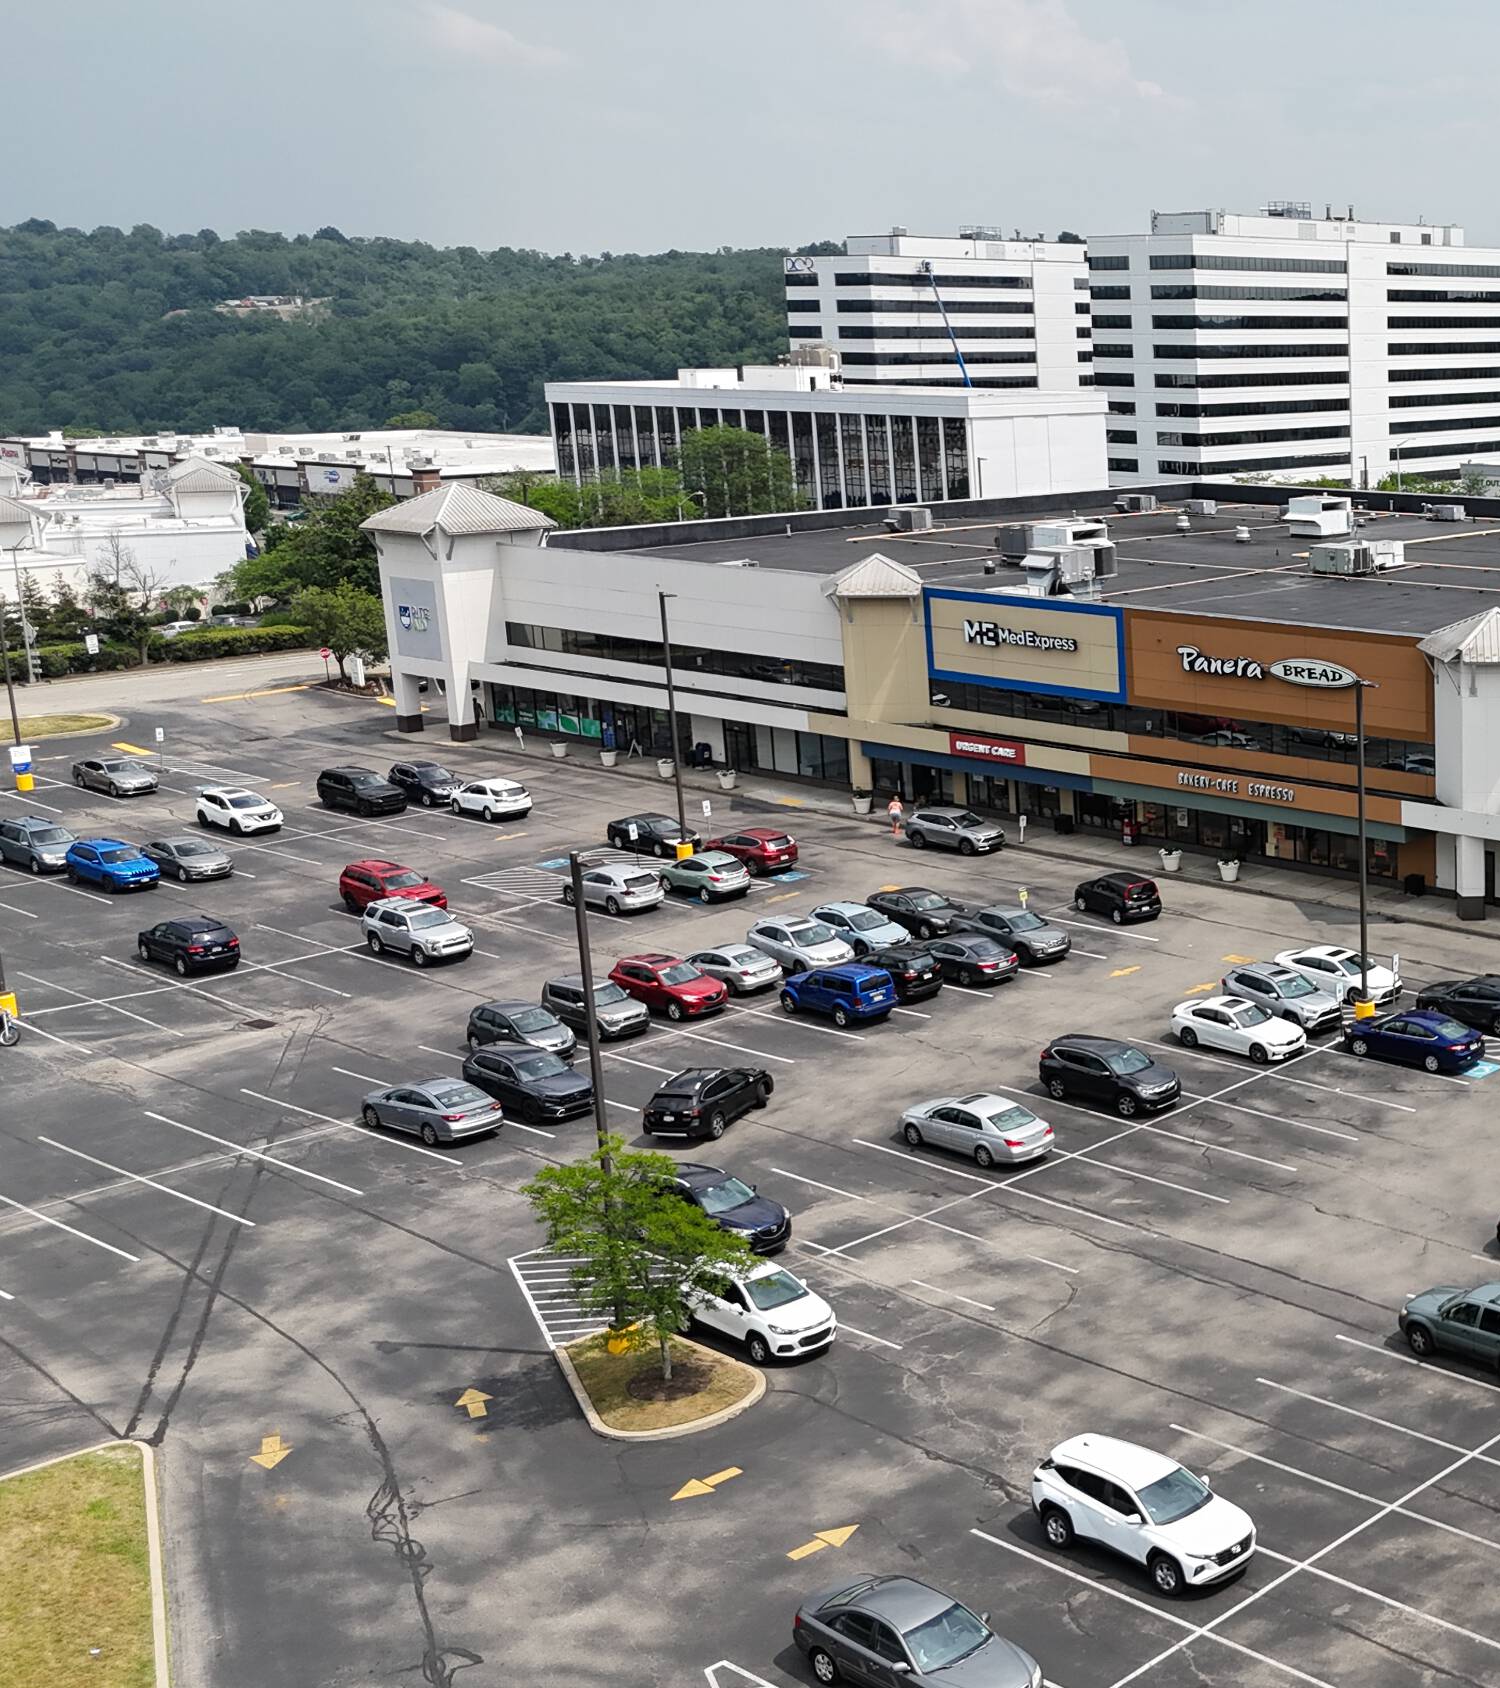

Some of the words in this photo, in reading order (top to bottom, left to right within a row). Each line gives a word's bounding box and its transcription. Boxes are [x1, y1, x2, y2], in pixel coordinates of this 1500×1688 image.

[998, 627, 1079, 652] MedExpress
[1176, 644, 1264, 680] Panera
[1282, 664, 1343, 683] BREAD
[955, 741, 991, 754] URGENT
[991, 746, 1017, 758] CARE
[1178, 772, 1238, 793] BAKERY-CAFE
[1248, 783, 1295, 801] ESPRESSO
